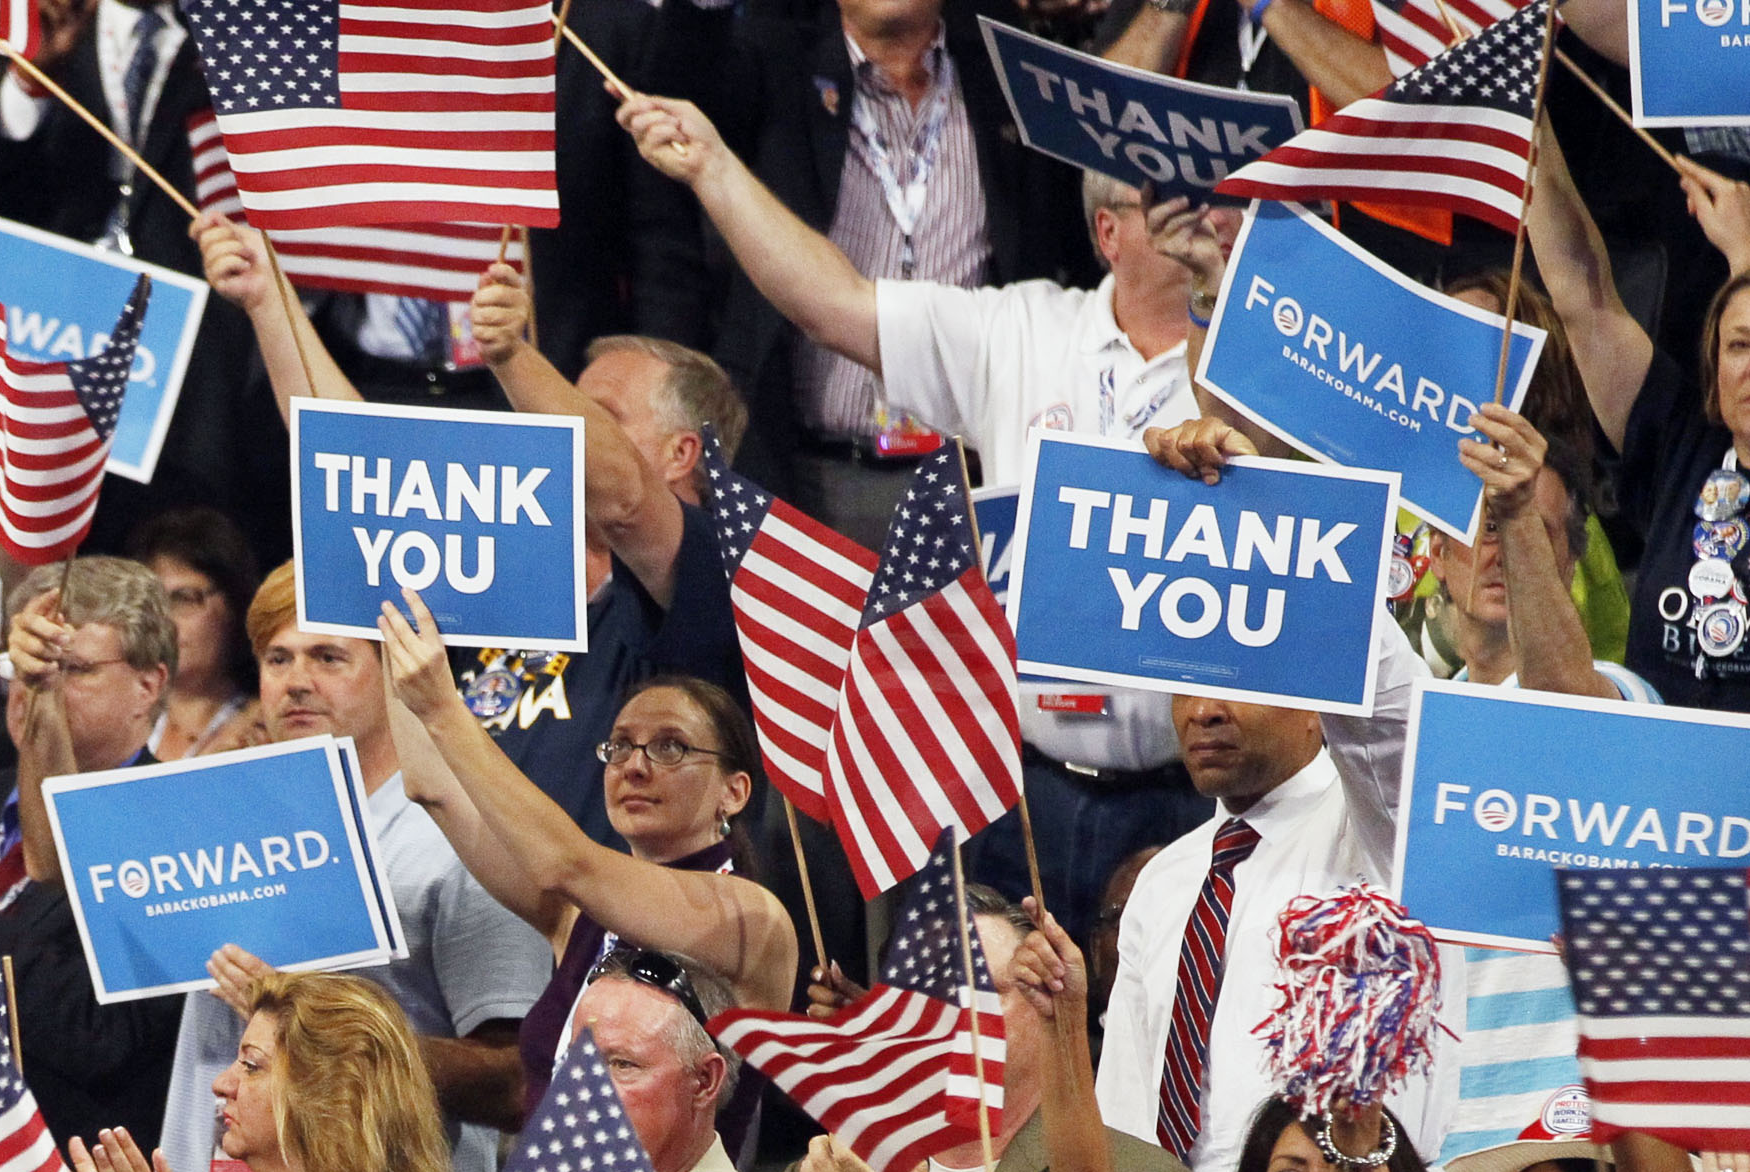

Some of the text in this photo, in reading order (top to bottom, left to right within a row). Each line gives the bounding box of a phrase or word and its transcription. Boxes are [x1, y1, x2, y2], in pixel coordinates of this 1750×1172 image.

[1020, 61, 1271, 157] THANK
[1078, 119, 1231, 189] YOU
[1244, 275, 1485, 445] FORWARD.
[1281, 344, 1422, 433] BARACKOBAMA.COM
[314, 452, 552, 526] THANK
[352, 526, 496, 595] YOU
[1058, 486, 1359, 584] THANK
[1107, 567, 1287, 648] YOU
[88, 830, 340, 904] FORWARD.
[144, 884, 287, 918] BARACKOBAMA.COM
